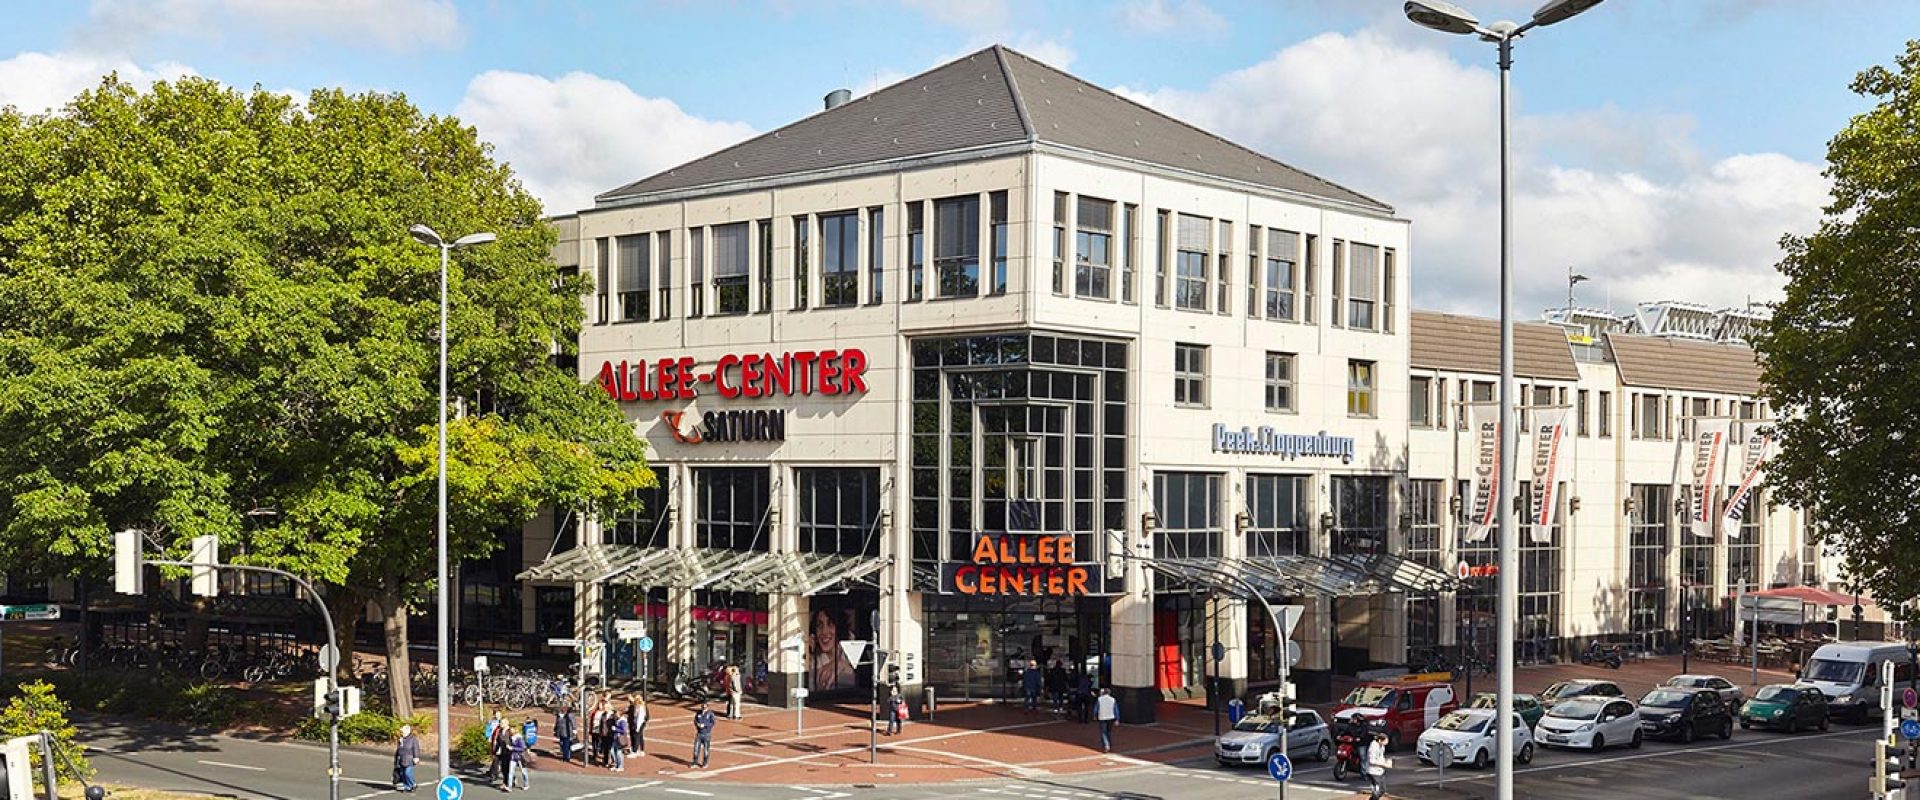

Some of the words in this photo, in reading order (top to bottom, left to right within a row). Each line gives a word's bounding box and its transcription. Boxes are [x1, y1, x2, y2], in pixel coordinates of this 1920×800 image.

[600, 348, 868, 401] ALLEE-CENTER
[703, 409, 785, 442] SATURN
[973, 534, 1073, 564] ALLEE
[955, 565, 1088, 595] CENTER
